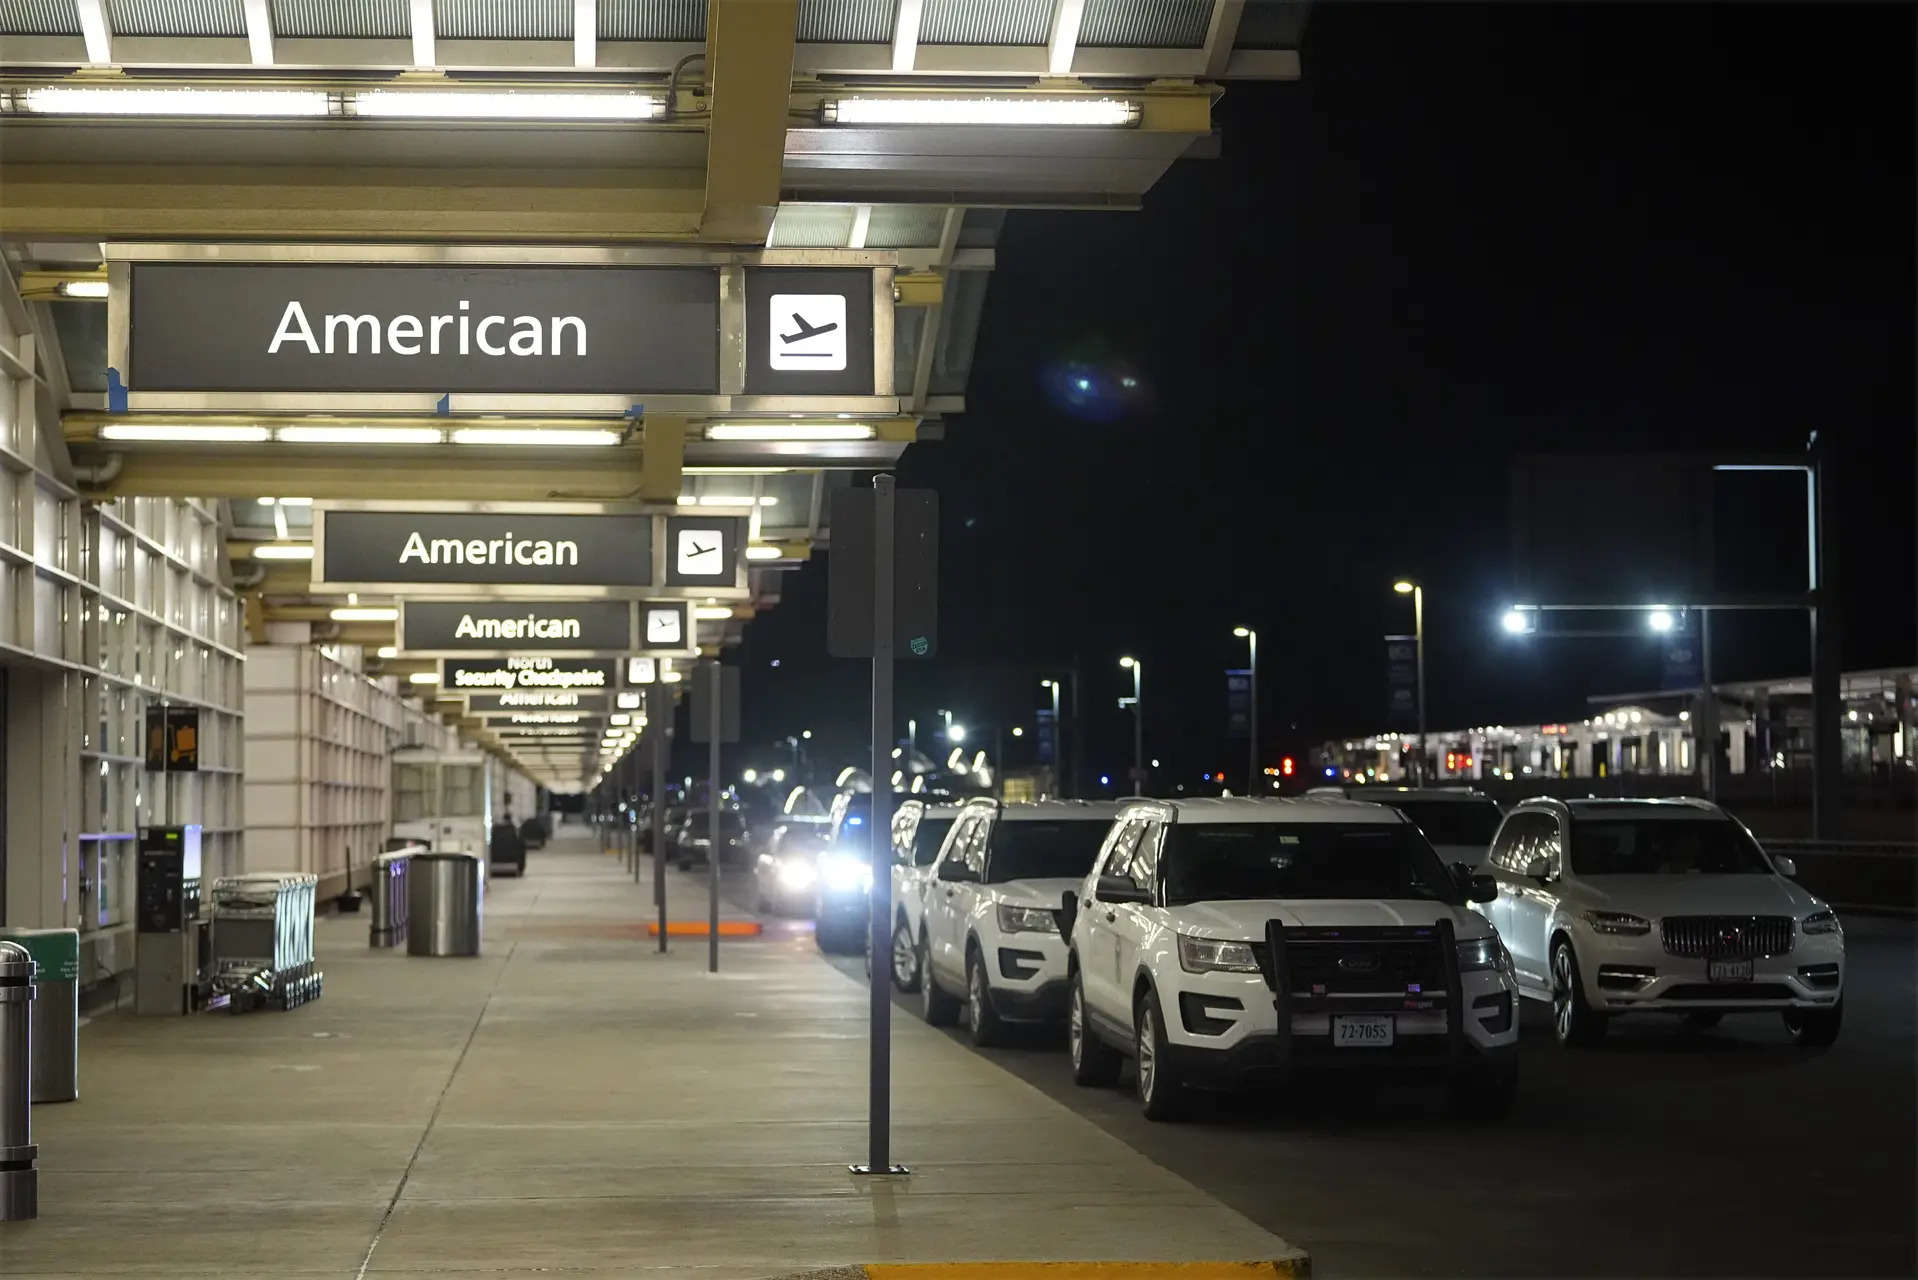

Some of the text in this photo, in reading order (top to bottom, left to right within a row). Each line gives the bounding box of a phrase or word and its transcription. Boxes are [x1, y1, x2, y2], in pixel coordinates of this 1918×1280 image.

[268, 300, 587, 356] American
[399, 531, 578, 566] American
[455, 614, 580, 638] American
[455, 669, 605, 689] Security Checkpoint
